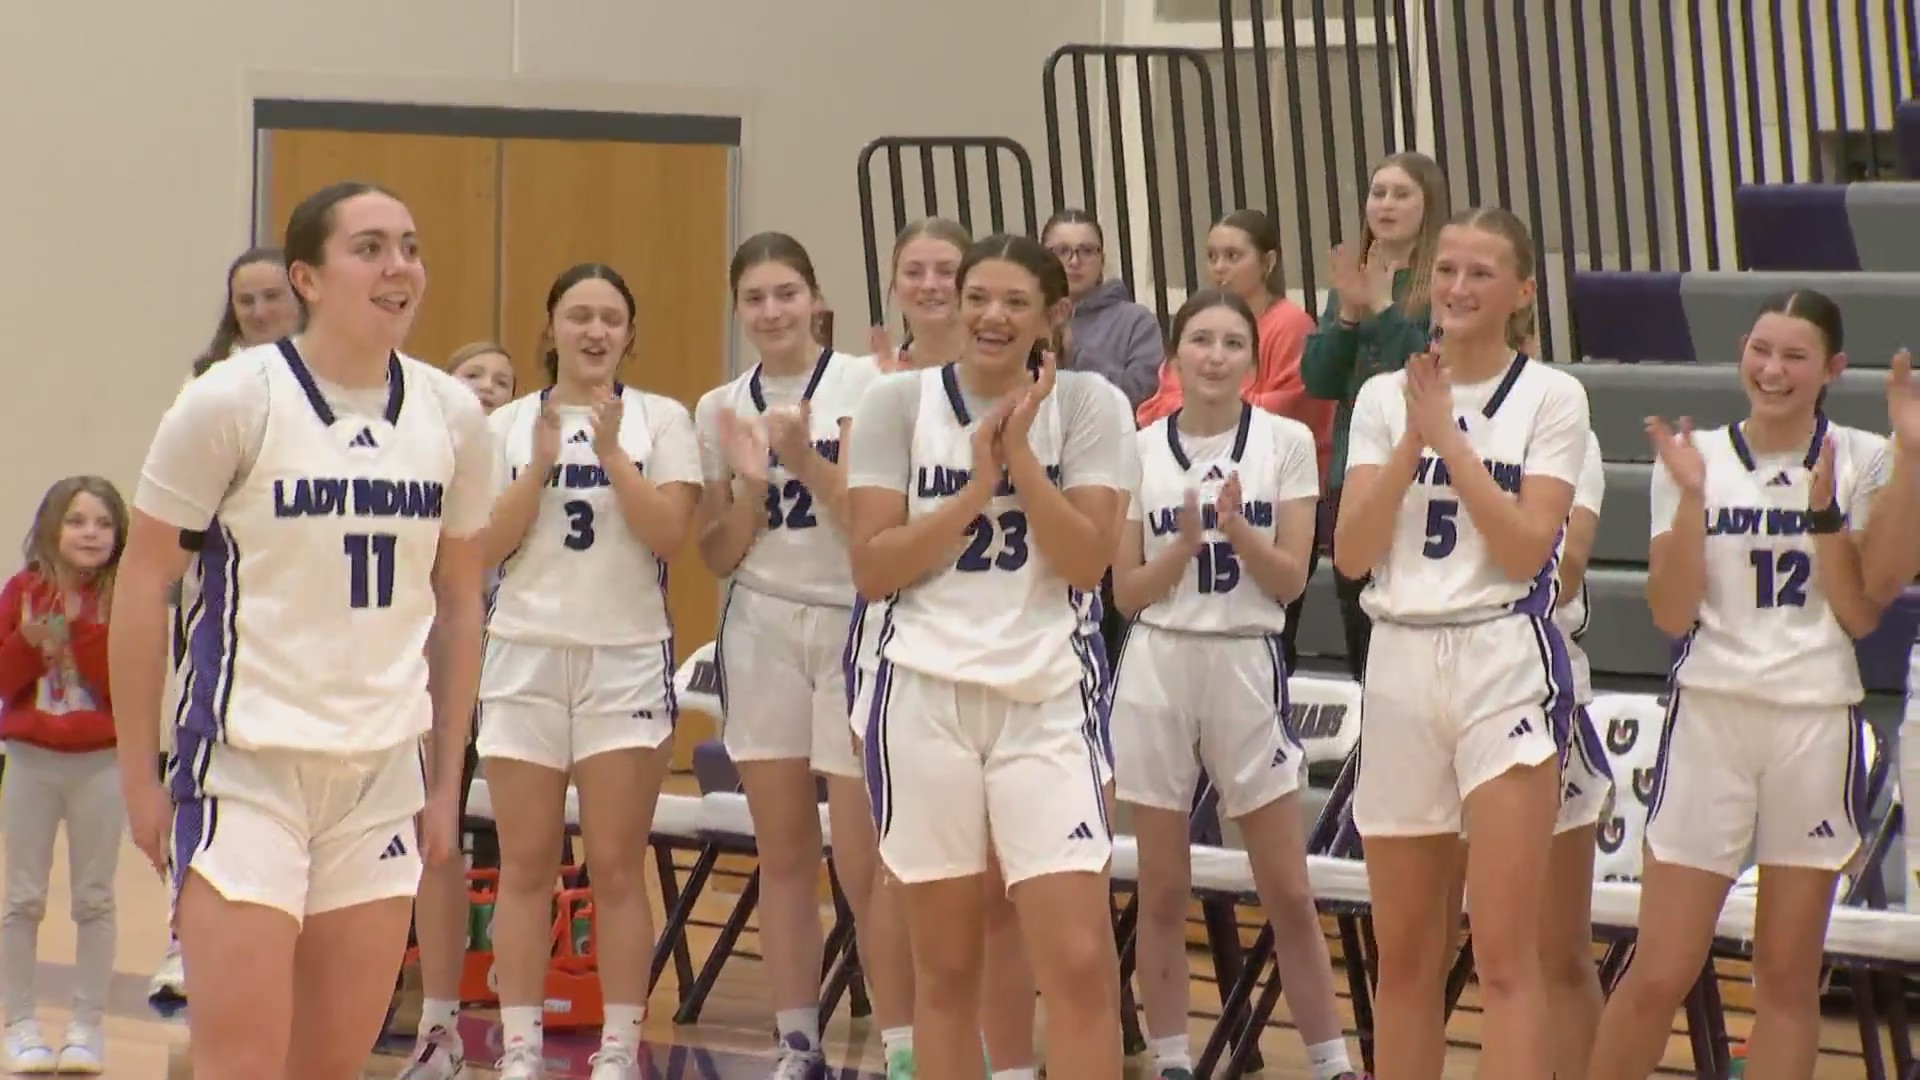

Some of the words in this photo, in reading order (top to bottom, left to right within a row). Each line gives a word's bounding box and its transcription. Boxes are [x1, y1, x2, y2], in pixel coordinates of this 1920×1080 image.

[274, 479, 347, 517] LADY
[564, 501, 595, 550] 3
[1705, 508, 1763, 535] LADY
[956, 510, 1028, 571] 23
[1422, 500, 1458, 560] 5
[343, 534, 397, 608] 11
[1195, 542, 1240, 594] 15
[1750, 550, 1811, 608] 12
